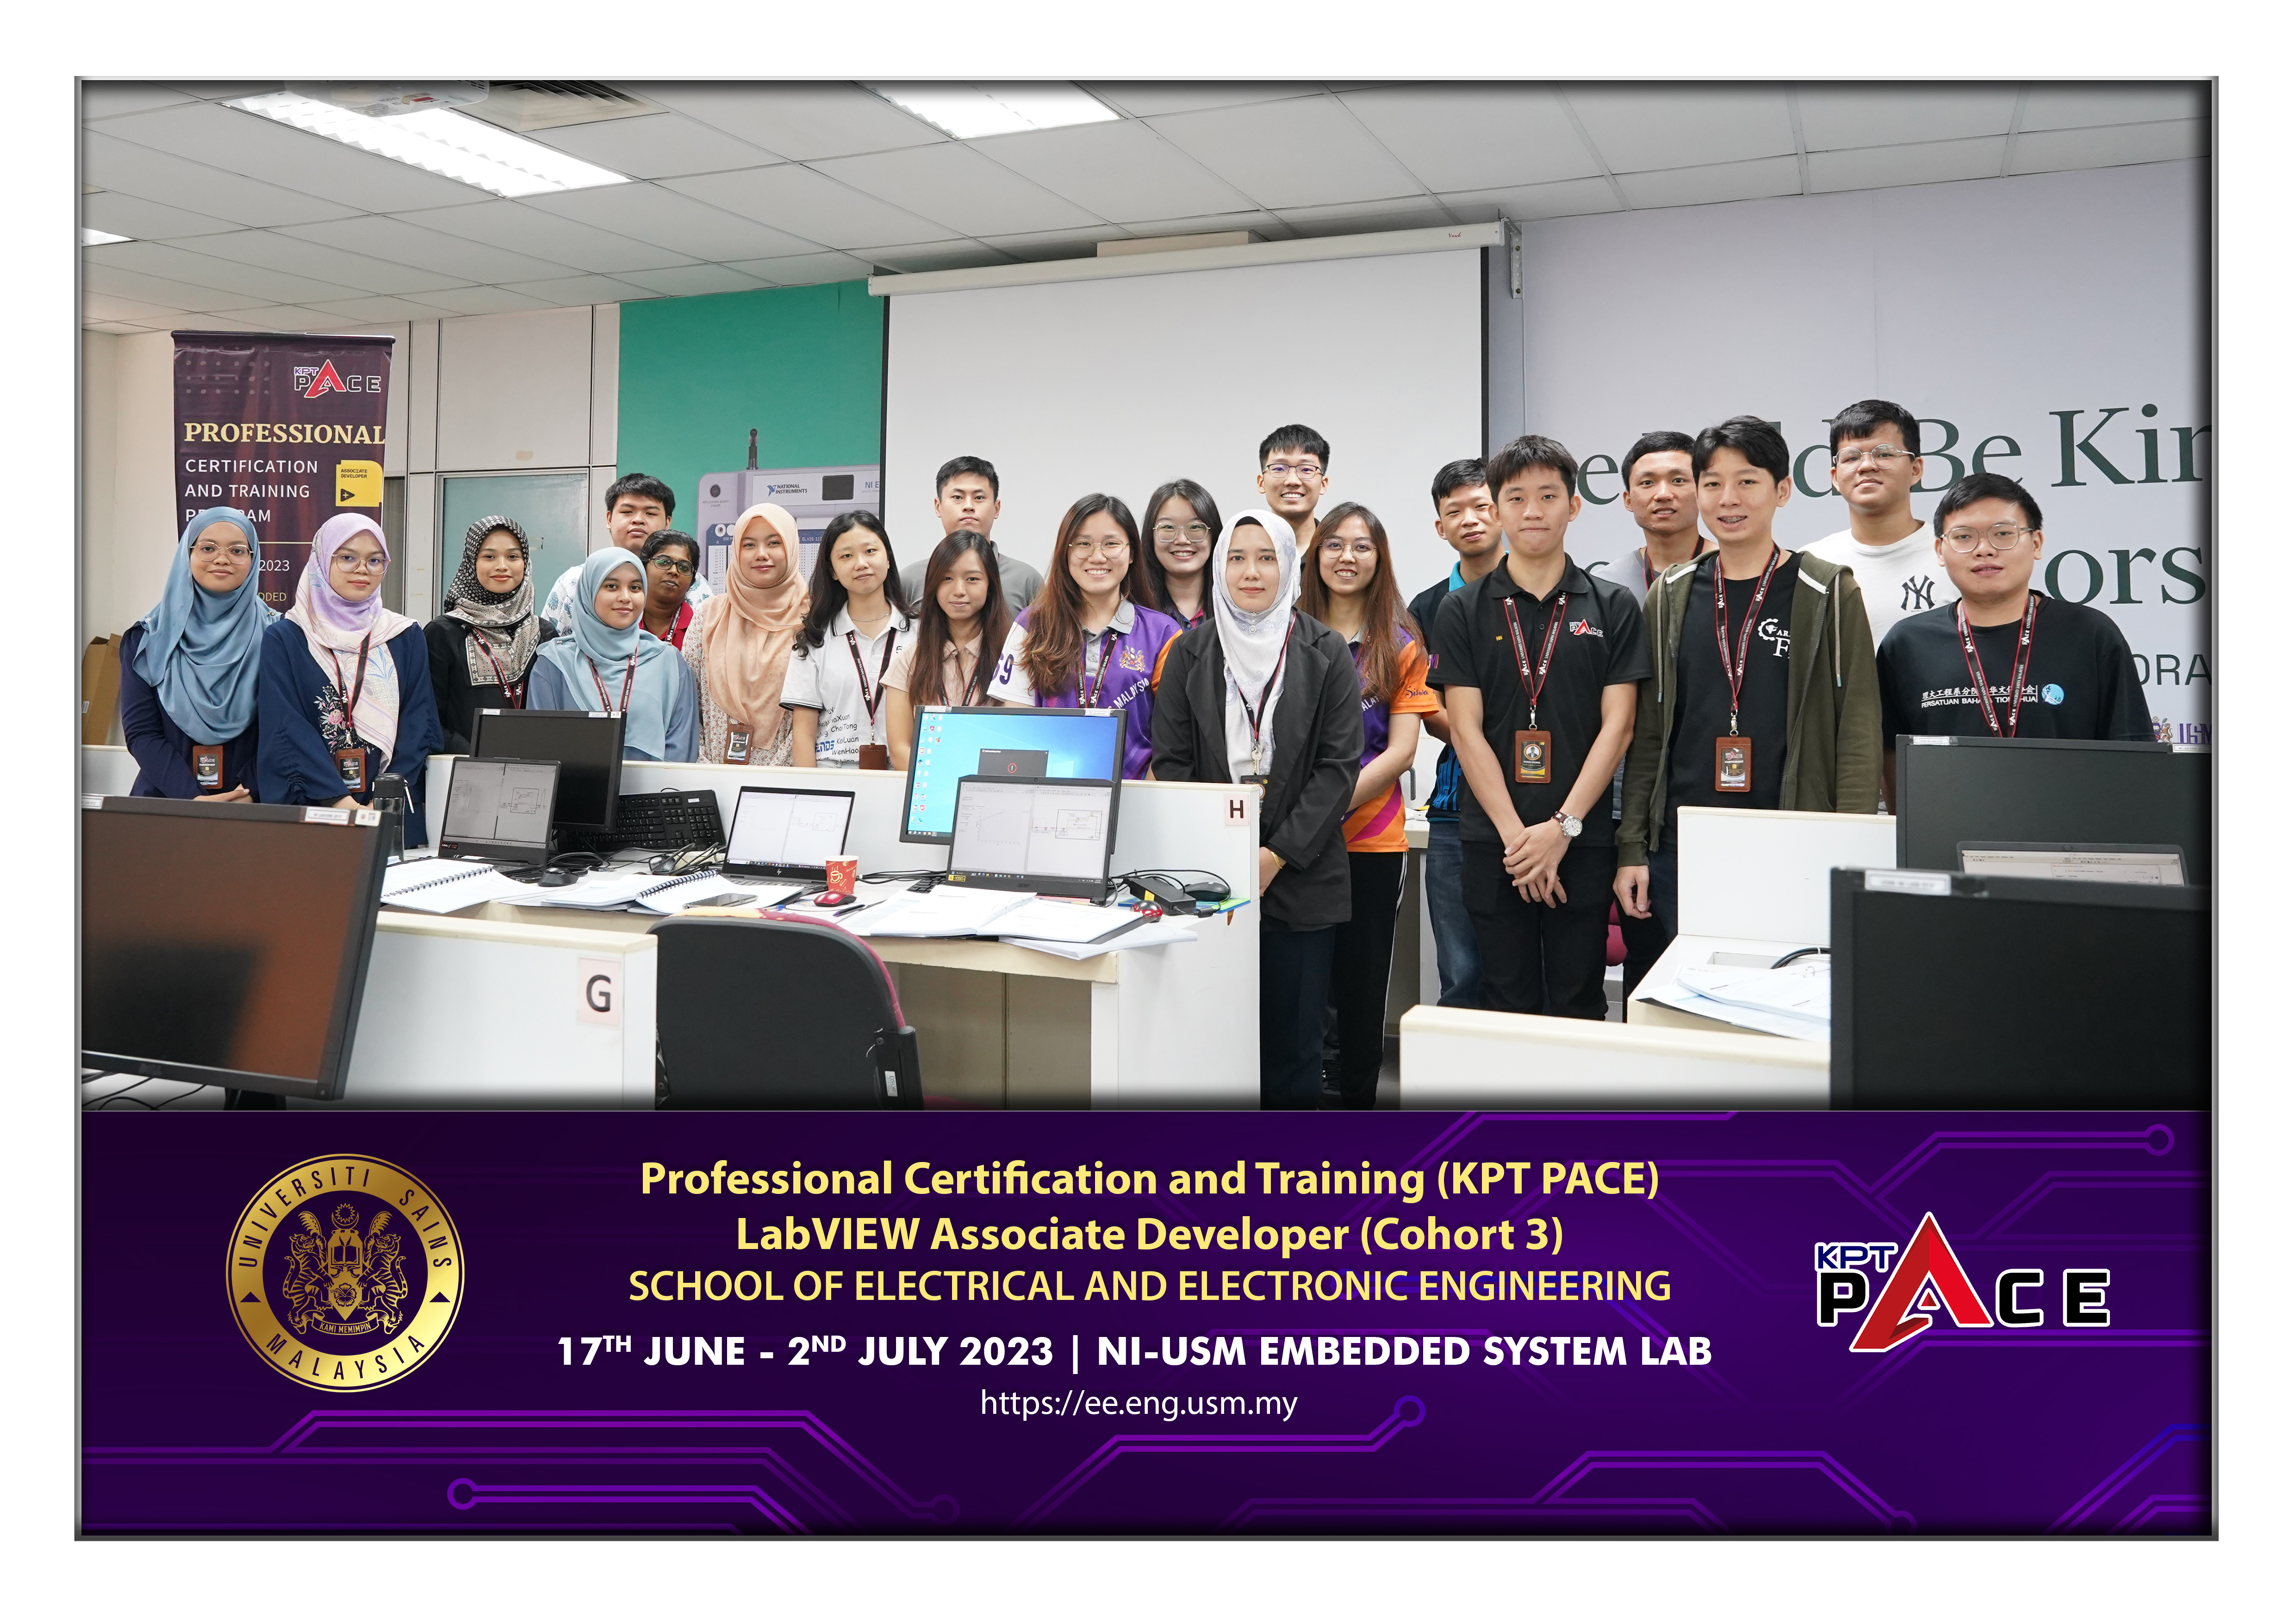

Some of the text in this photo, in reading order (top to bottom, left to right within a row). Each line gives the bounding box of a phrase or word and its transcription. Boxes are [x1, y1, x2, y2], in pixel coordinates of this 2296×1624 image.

[294, 367, 318, 376] KPT
[294, 359, 381, 398] PACE
[184, 422, 385, 444] PROFESSIONAL
[185, 459, 318, 474] CERTIFICATION
[185, 484, 310, 499] AND TRAINING
[259, 560, 290, 571] 2023
[2044, 547, 2206, 604] ors
[258, 593, 287, 601] DDED
[1569, 619, 1604, 637] PACE
[2021, 629, 2030, 645] PACE
[1521, 660, 1529, 675] PACE
[1538, 659, 1547, 675] PACE
[1089, 689, 1098, 704] PACE
[1114, 678, 1150, 709] MALAYSIA
[1405, 686, 1428, 699] Siswa
[1921, 697, 1959, 708] PERSATUAN
[831, 724, 857, 732] ChaiTong
[1989, 713, 1997, 731] PACE
[836, 737, 859, 745] KaiLuan
[832, 747, 859, 756] WenHao
[1230, 800, 1244, 818] H
[585, 974, 612, 1013] G
